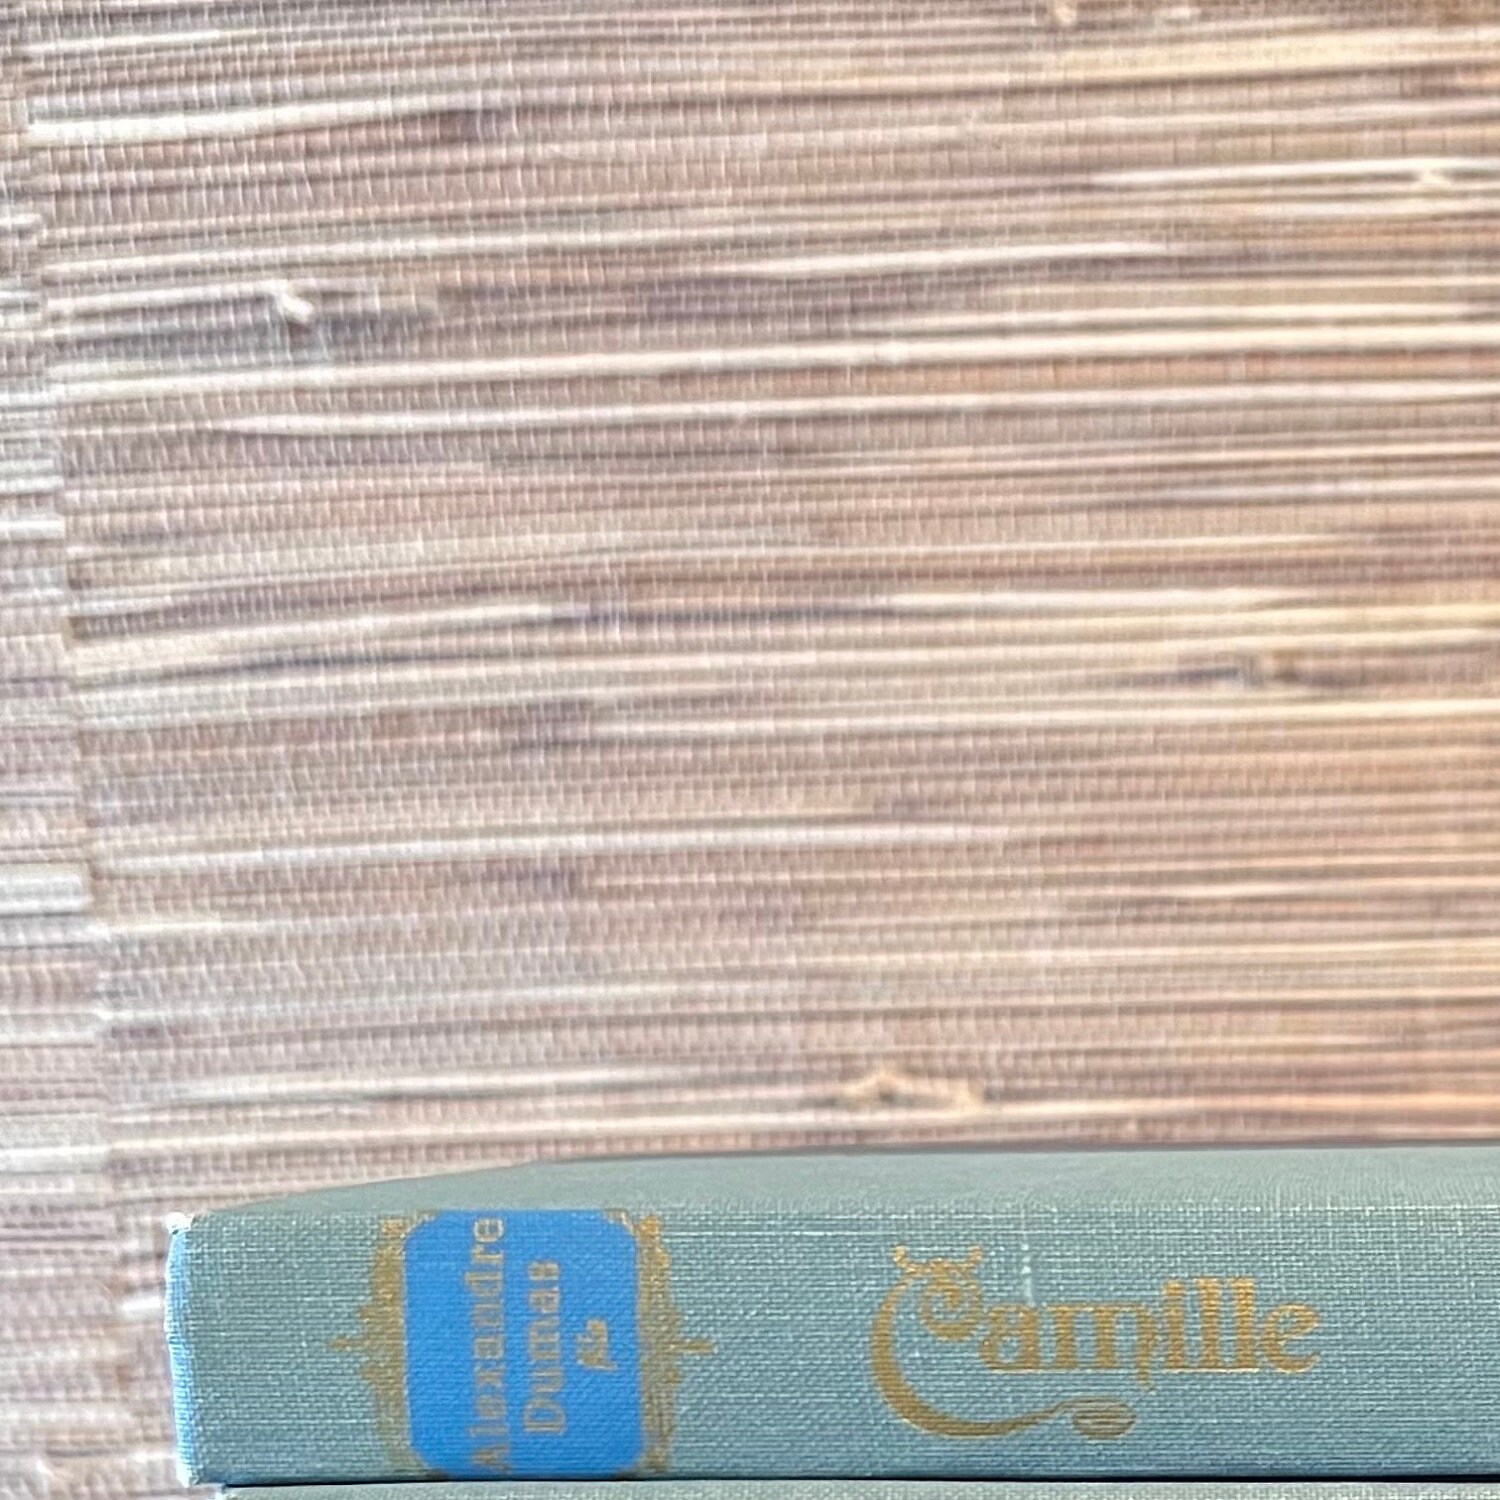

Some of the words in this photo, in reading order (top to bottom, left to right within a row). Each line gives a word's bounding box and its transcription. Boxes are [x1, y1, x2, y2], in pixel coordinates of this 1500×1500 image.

[462, 1215, 510, 1475] Alexandre
[522, 1259, 567, 1436] Dumas
[869, 1245, 1320, 1441] Camille
